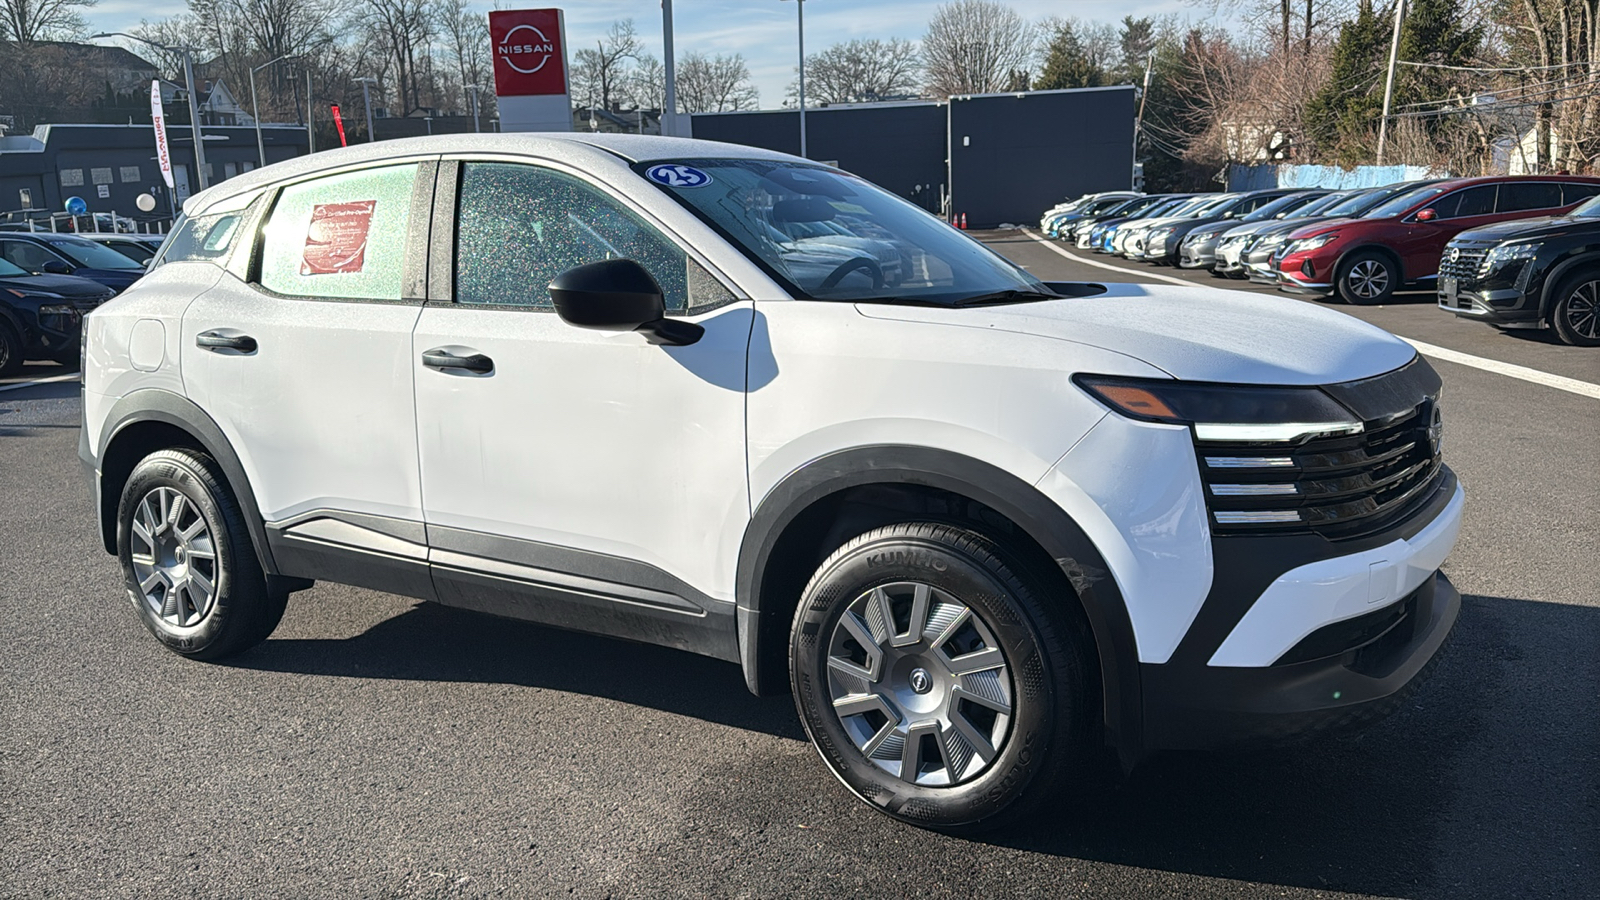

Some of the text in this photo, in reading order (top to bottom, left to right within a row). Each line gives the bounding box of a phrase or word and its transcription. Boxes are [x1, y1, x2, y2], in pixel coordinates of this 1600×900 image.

[498, 44, 553, 54] NISSAN
[658, 166, 700, 186] 25
[866, 551, 948, 572] KUMHO
[987, 730, 1034, 803] SOLUS
